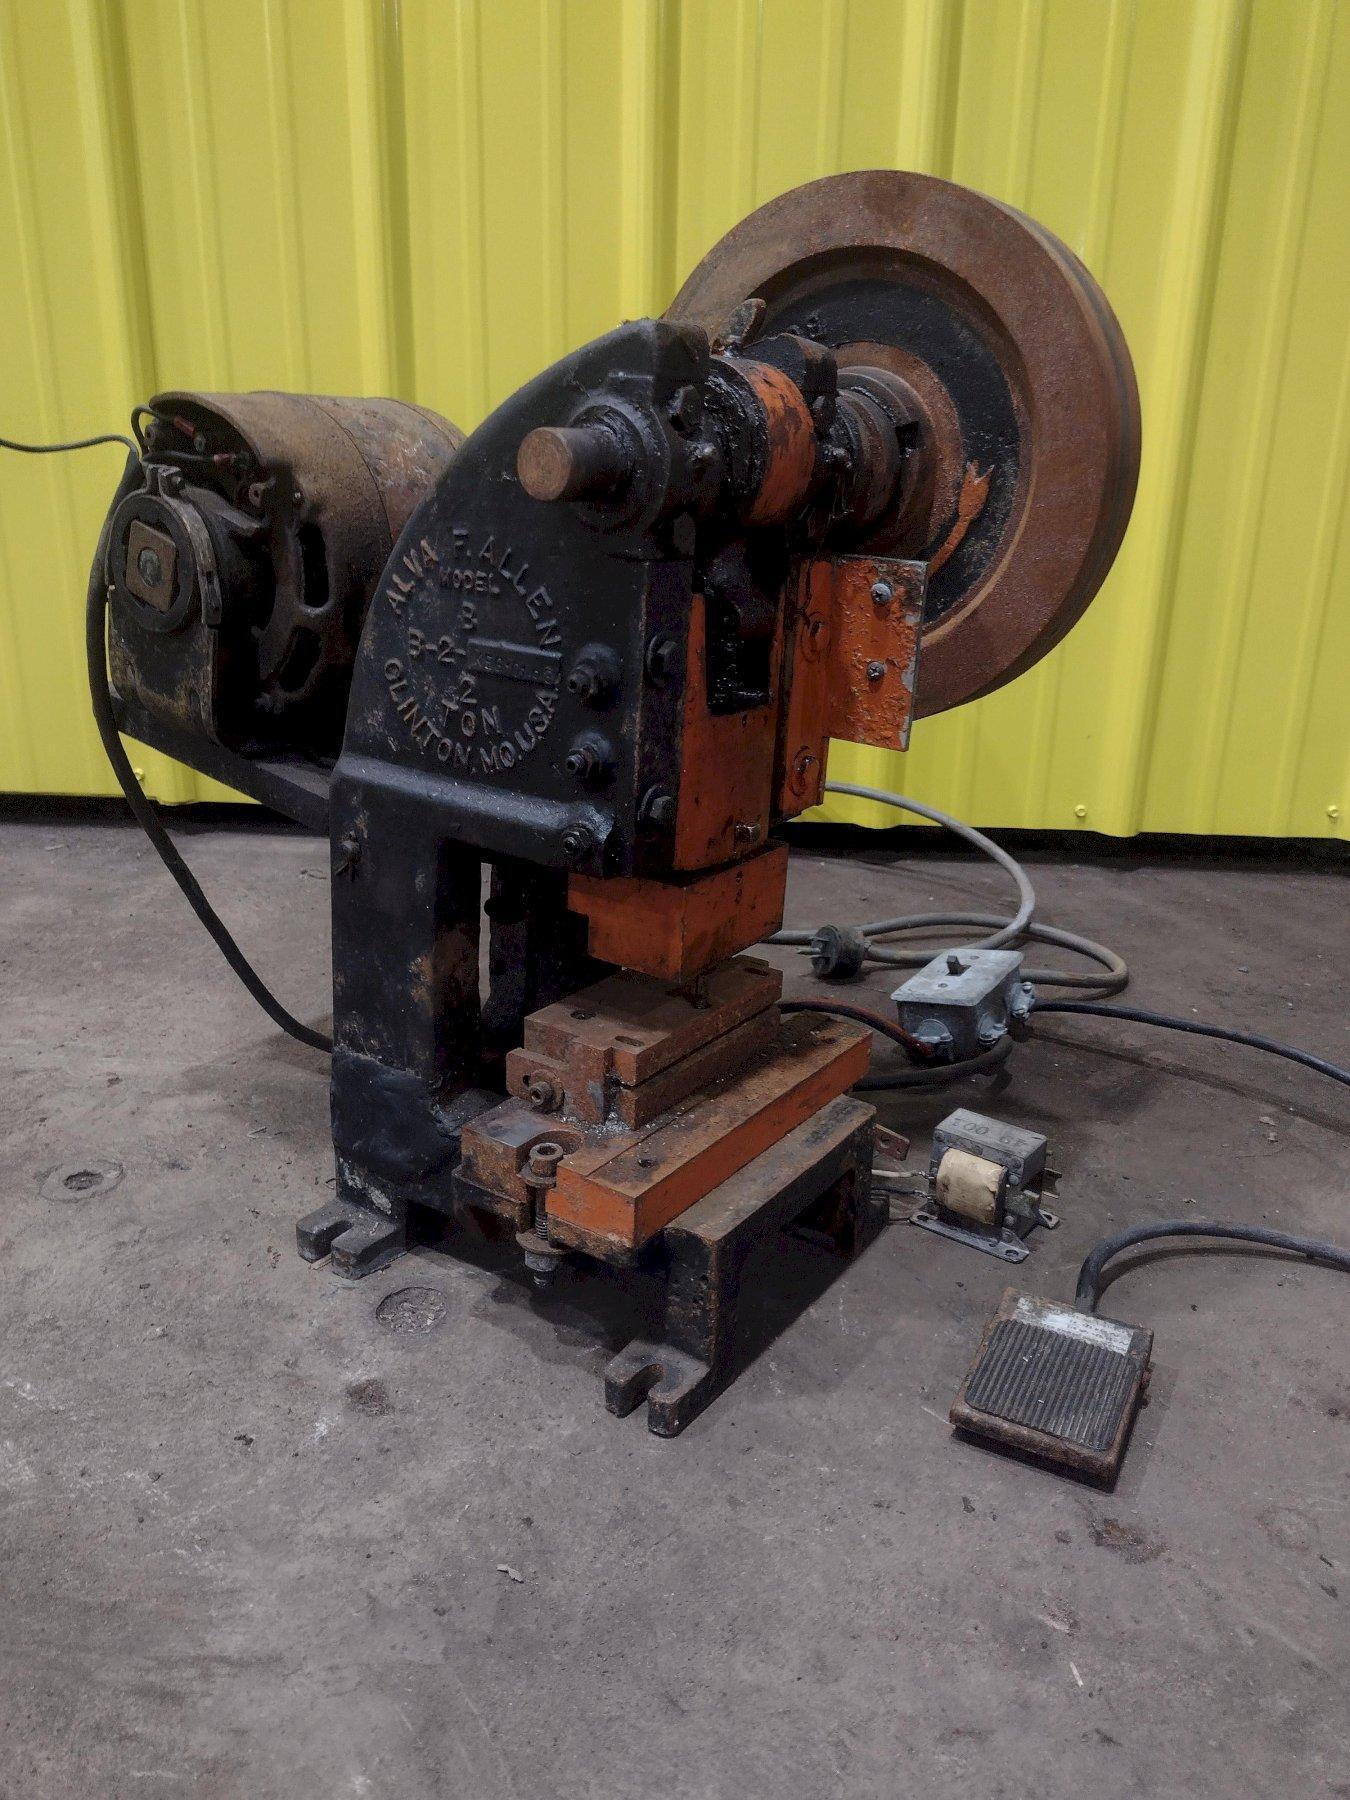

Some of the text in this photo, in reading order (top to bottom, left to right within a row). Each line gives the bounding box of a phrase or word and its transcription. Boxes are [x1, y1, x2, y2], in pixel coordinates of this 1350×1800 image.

[386, 535, 438, 615] ALVA
[479, 535, 561, 649] ALLEN
[438, 566, 500, 595] MODEL
